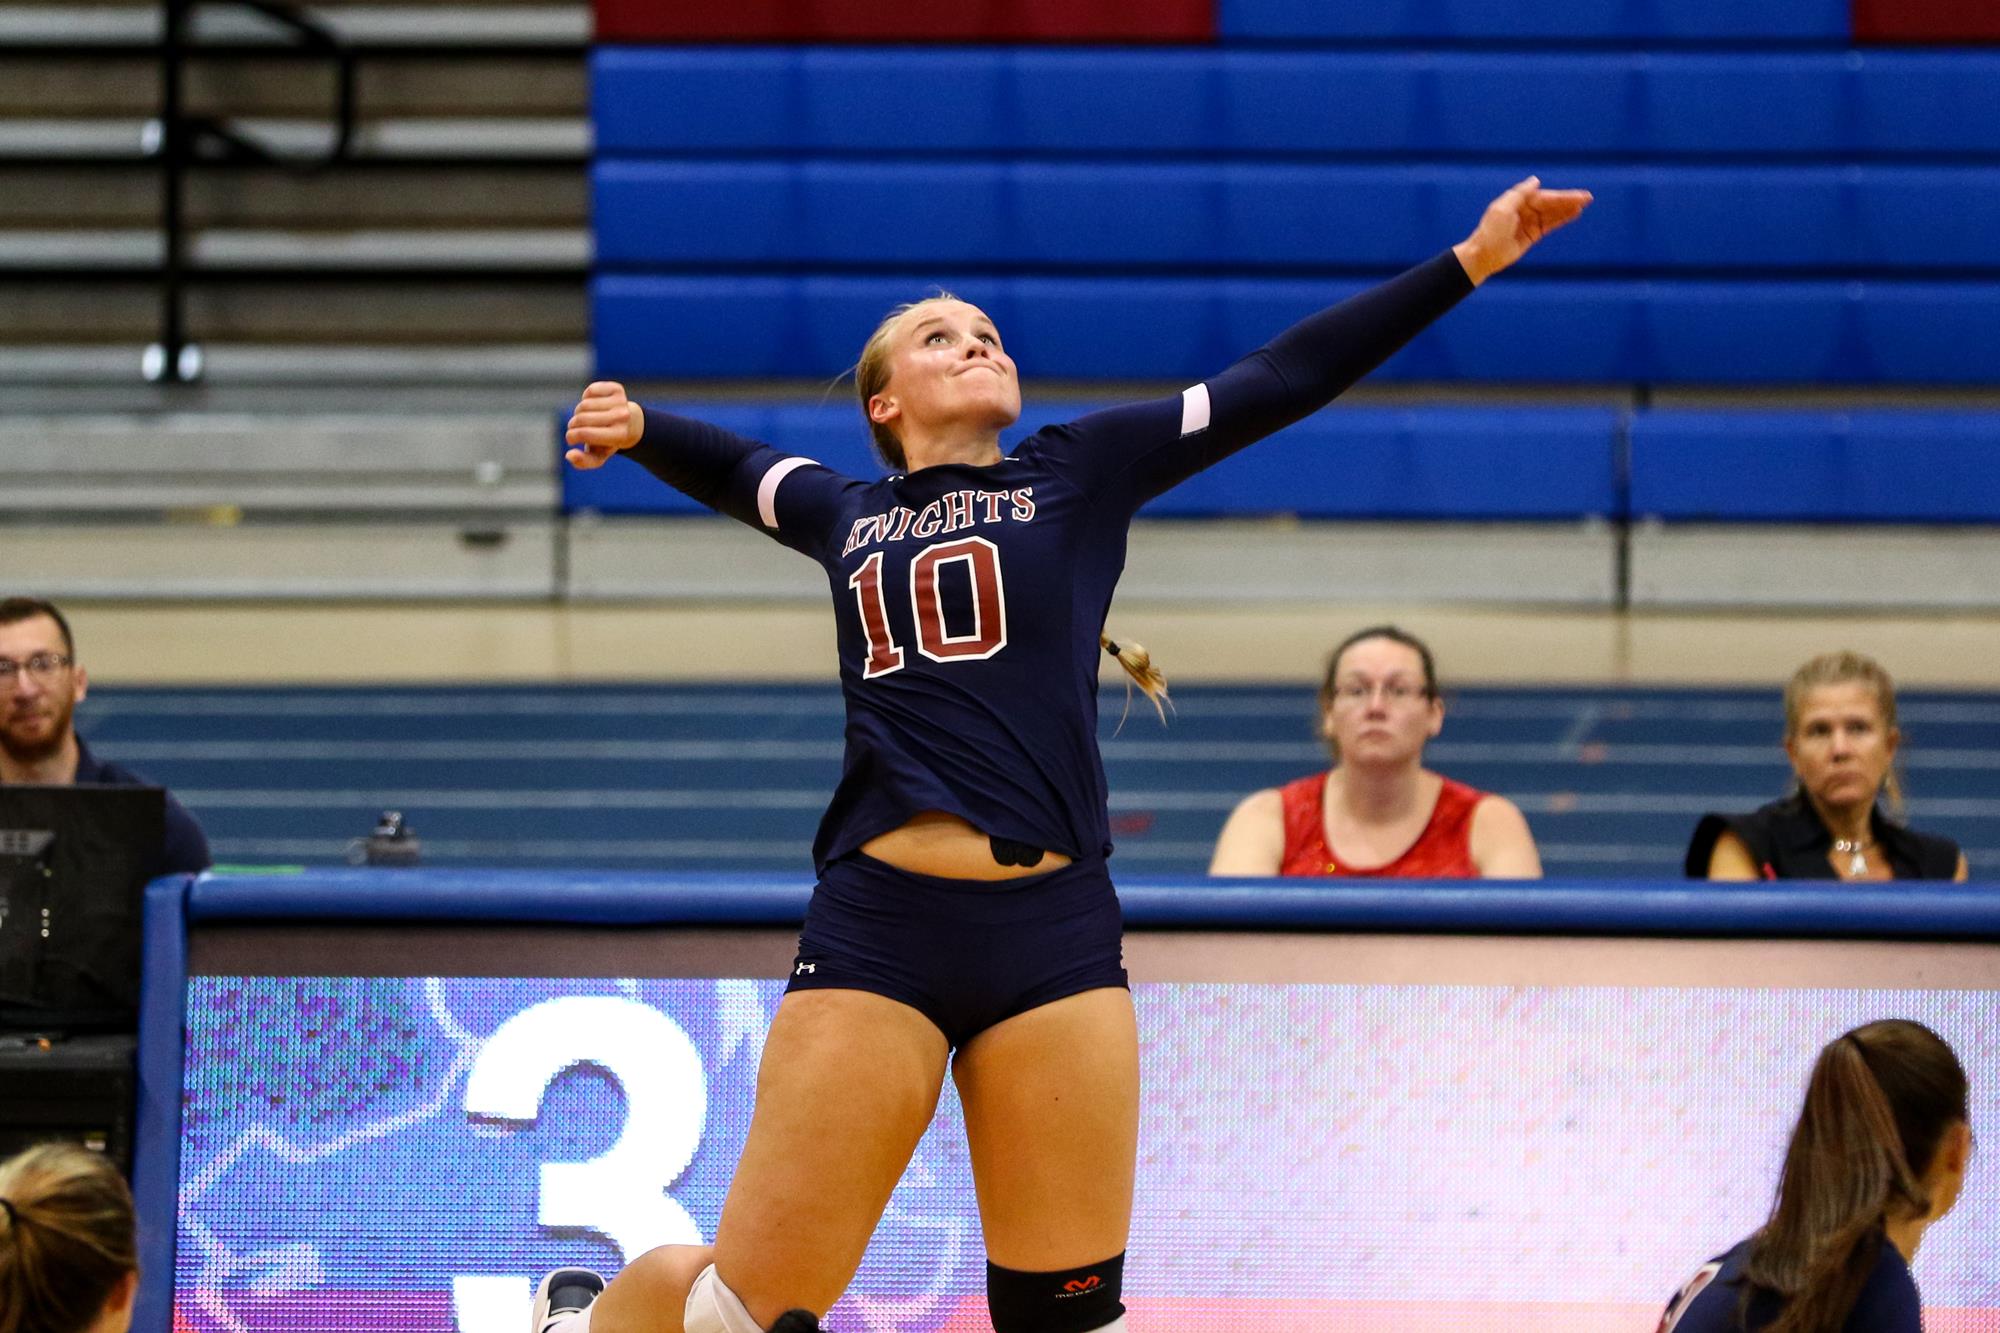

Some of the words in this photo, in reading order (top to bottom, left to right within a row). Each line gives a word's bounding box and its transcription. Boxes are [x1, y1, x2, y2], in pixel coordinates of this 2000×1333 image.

[842, 486, 1036, 557] KNIGHTS
[849, 535, 1008, 680] 10
[454, 995, 709, 1333] 3
